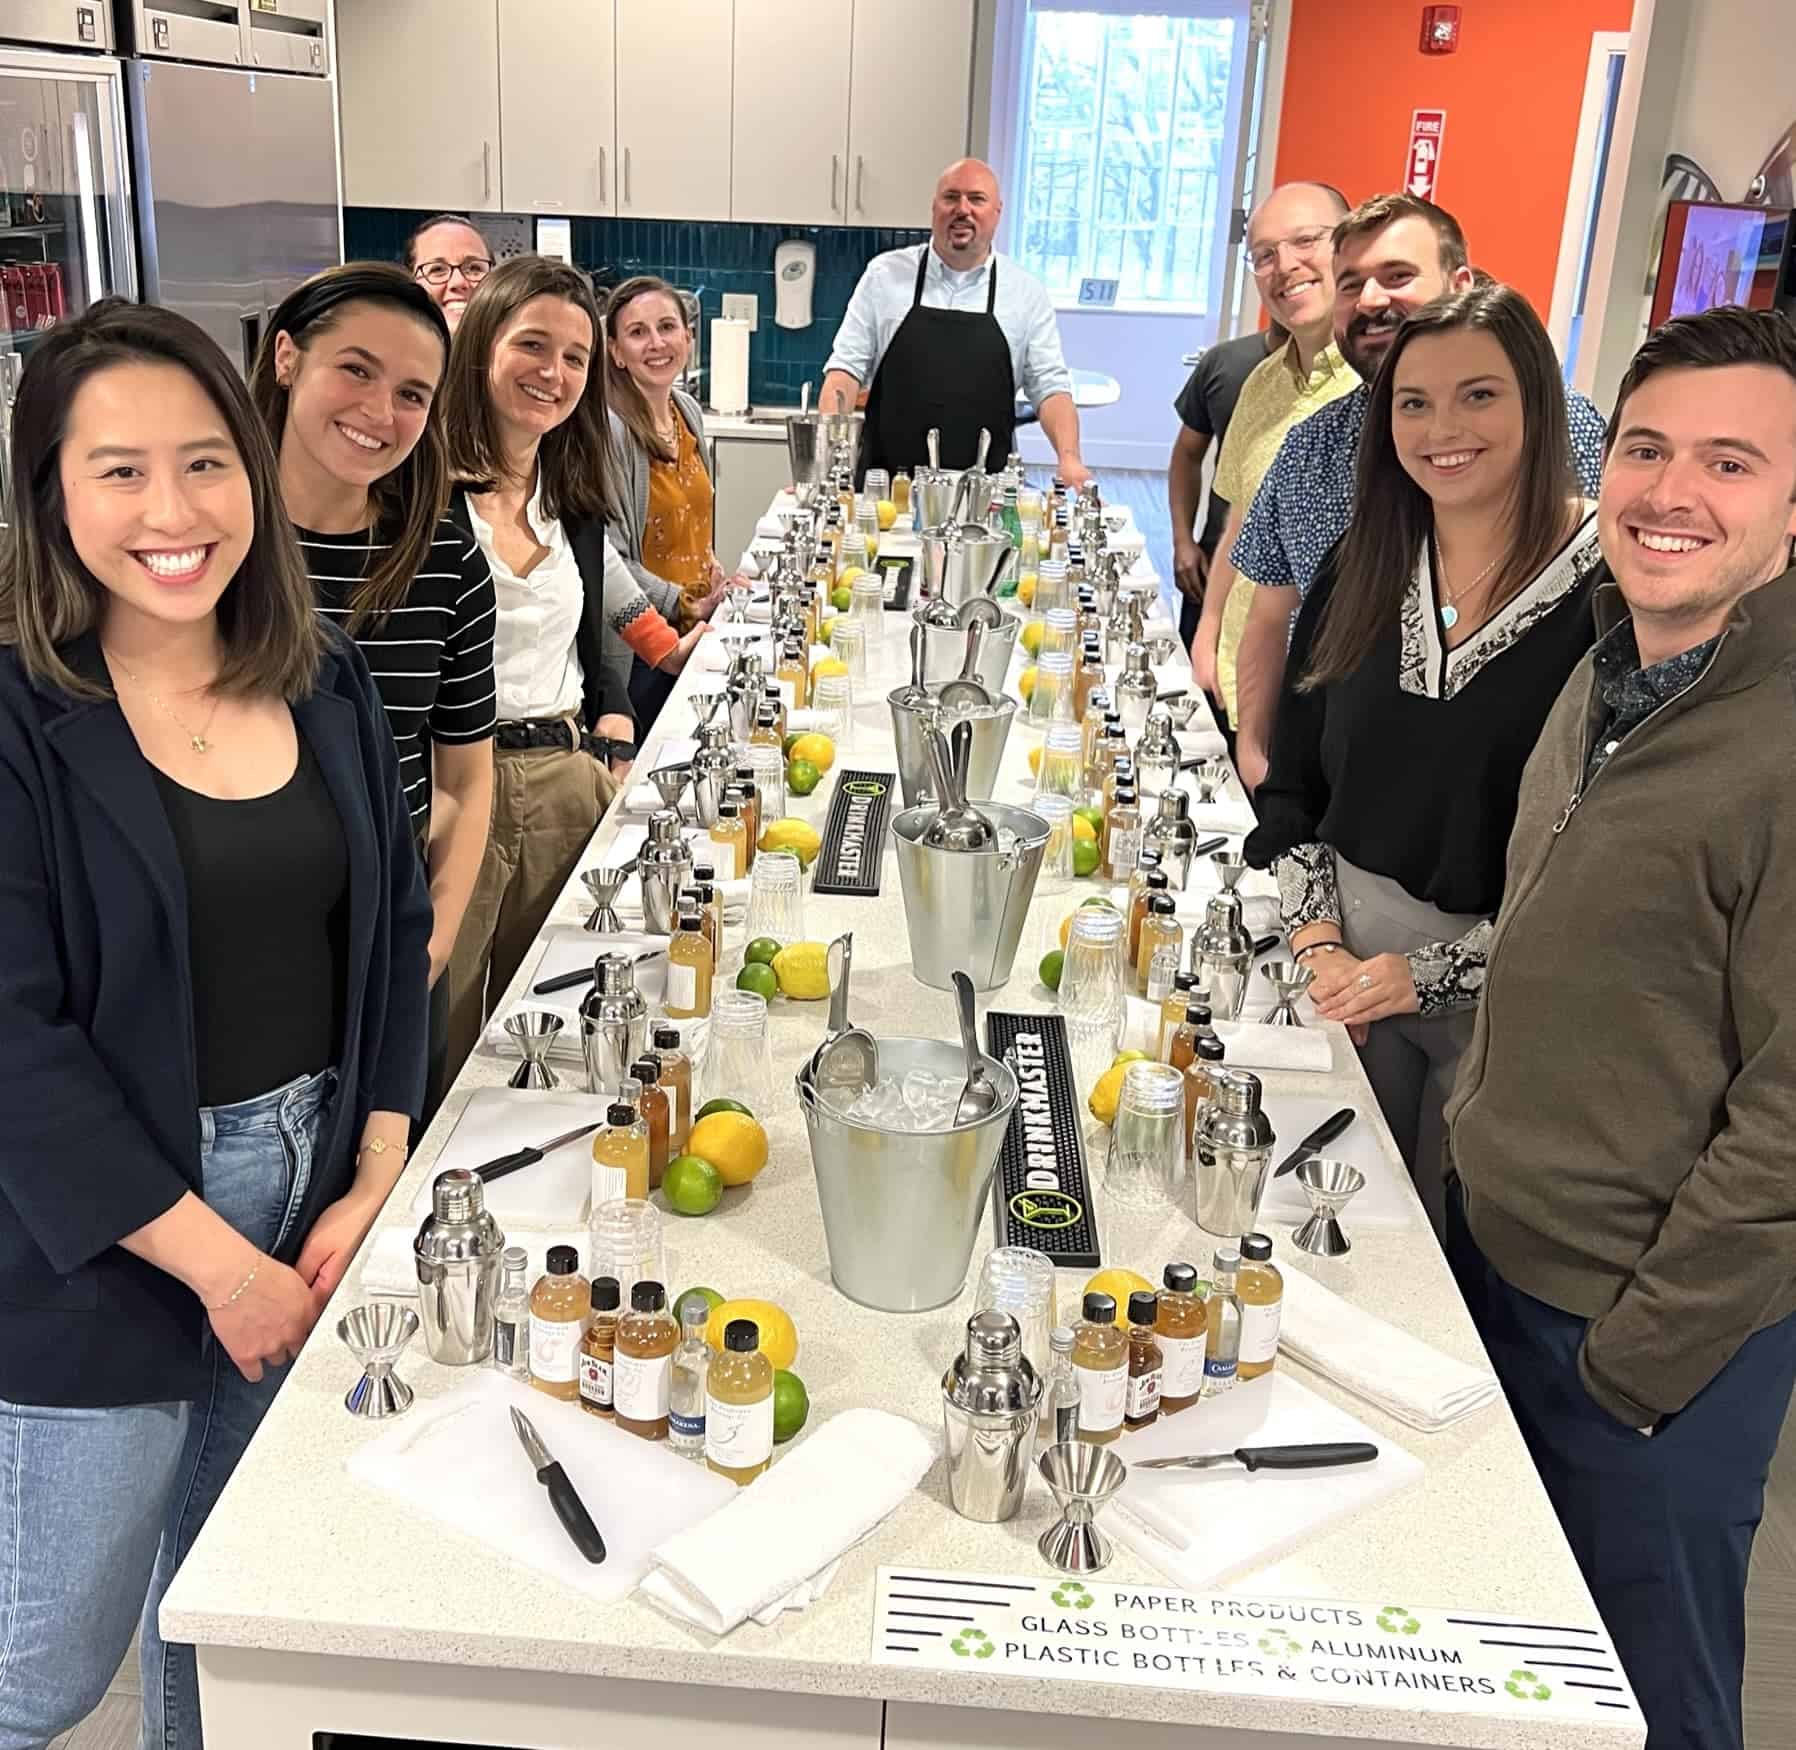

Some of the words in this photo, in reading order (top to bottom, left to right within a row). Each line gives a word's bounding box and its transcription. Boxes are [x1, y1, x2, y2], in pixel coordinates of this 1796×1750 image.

[1415, 120, 1441, 133] FIRE
[837, 795, 873, 878] DRINKMASTER
[1015, 1032, 1060, 1190] DRINKMASTER
[1114, 1592, 1199, 1614] PAPER
[1211, 1599, 1363, 1627] PRODUCTS
[1021, 1613, 1108, 1637] GLASS
[1311, 1639, 1464, 1665] ALUMINUM
[1004, 1641, 1120, 1667] PLASTIC
[1132, 1652, 1265, 1677] BOTTLES
[1277, 1663, 1297, 1681] &
[1310, 1665, 1496, 1695] CONTAINERS
